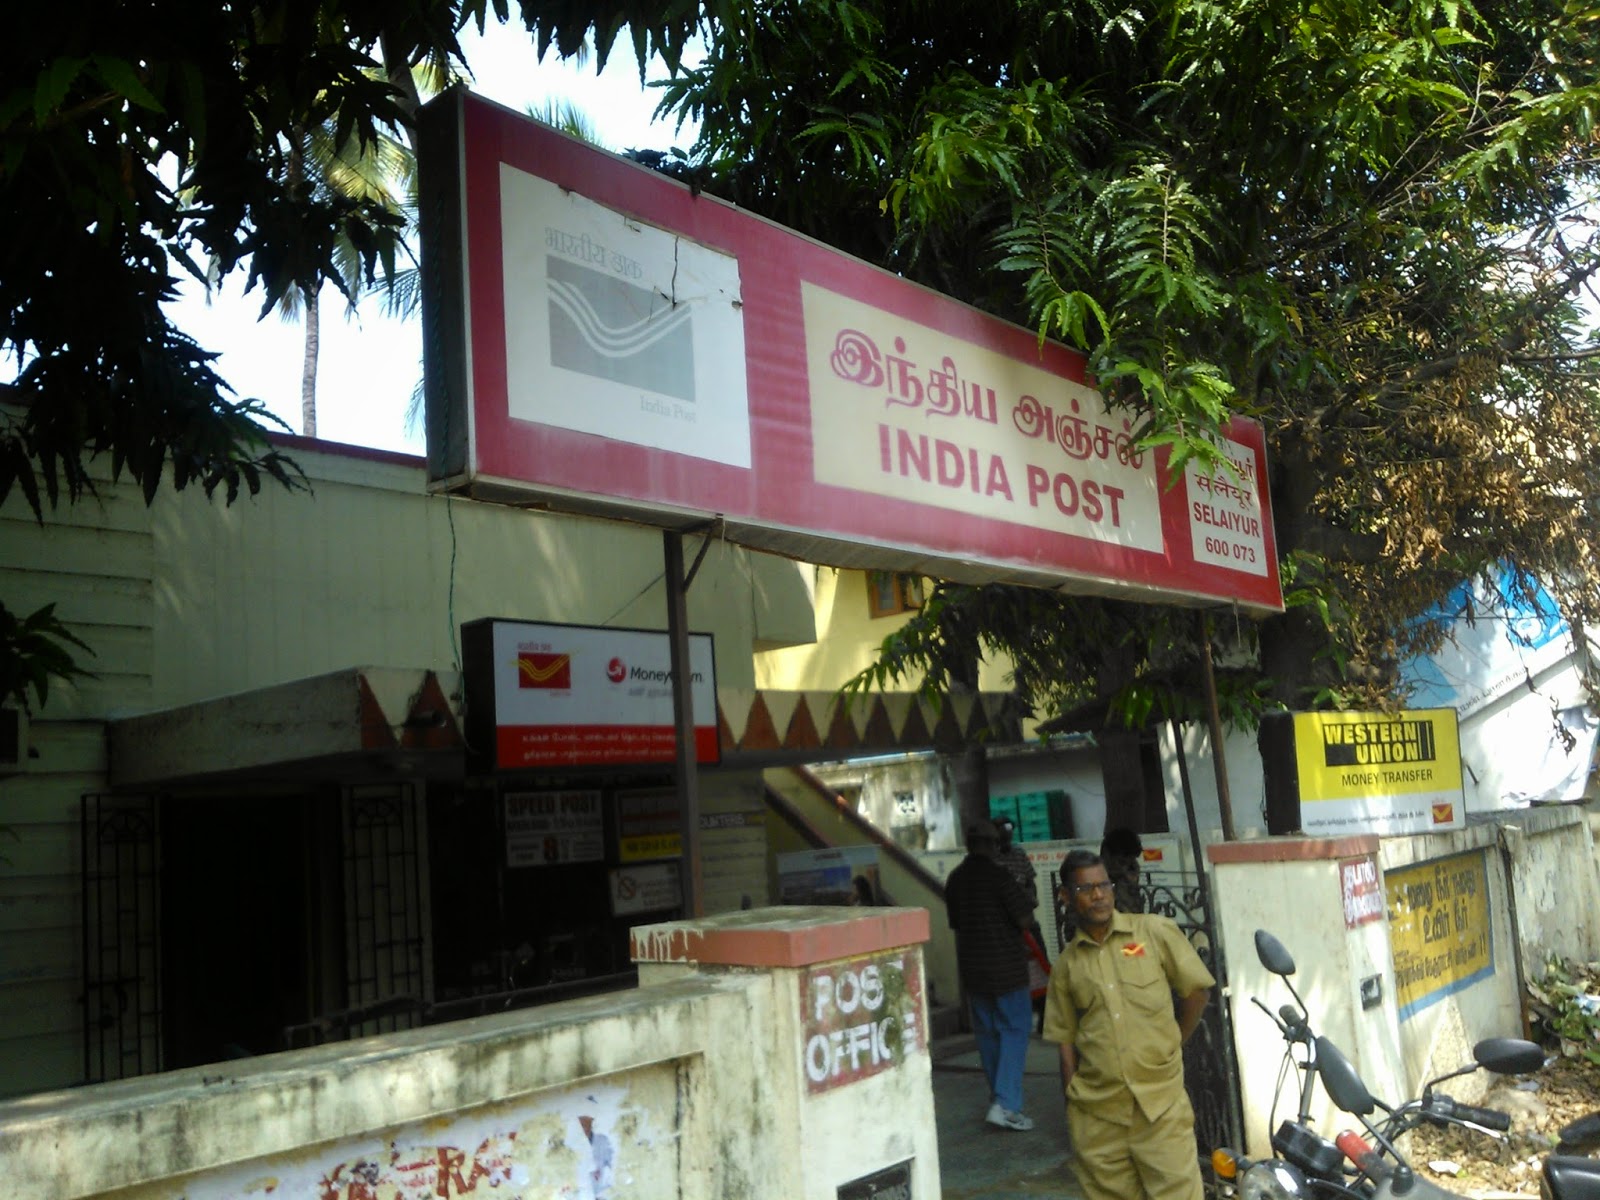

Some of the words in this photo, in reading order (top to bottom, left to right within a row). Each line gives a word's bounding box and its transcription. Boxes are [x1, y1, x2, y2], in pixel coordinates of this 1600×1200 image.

[545, 226, 606, 268] भारतीय
[611, 249, 644, 280] डाक
[639, 394, 671, 417] India
[673, 402, 697, 423] Post
[829, 328, 998, 425] இந்திய
[1012, 394, 1144, 470] அஞ்சல்
[878, 423, 1017, 501] INDIA
[1027, 464, 1125, 528] POST
[1193, 500, 1261, 538] SELAIYUR
[1205, 535, 1230, 557] 600
[1232, 542, 1256, 564] 073
[1323, 721, 1418, 745] WESTERN
[1355, 742, 1420, 765] UNION
[1341, 771, 1380, 787] MONEY
[1383, 768, 1433, 784] TRANSFER
